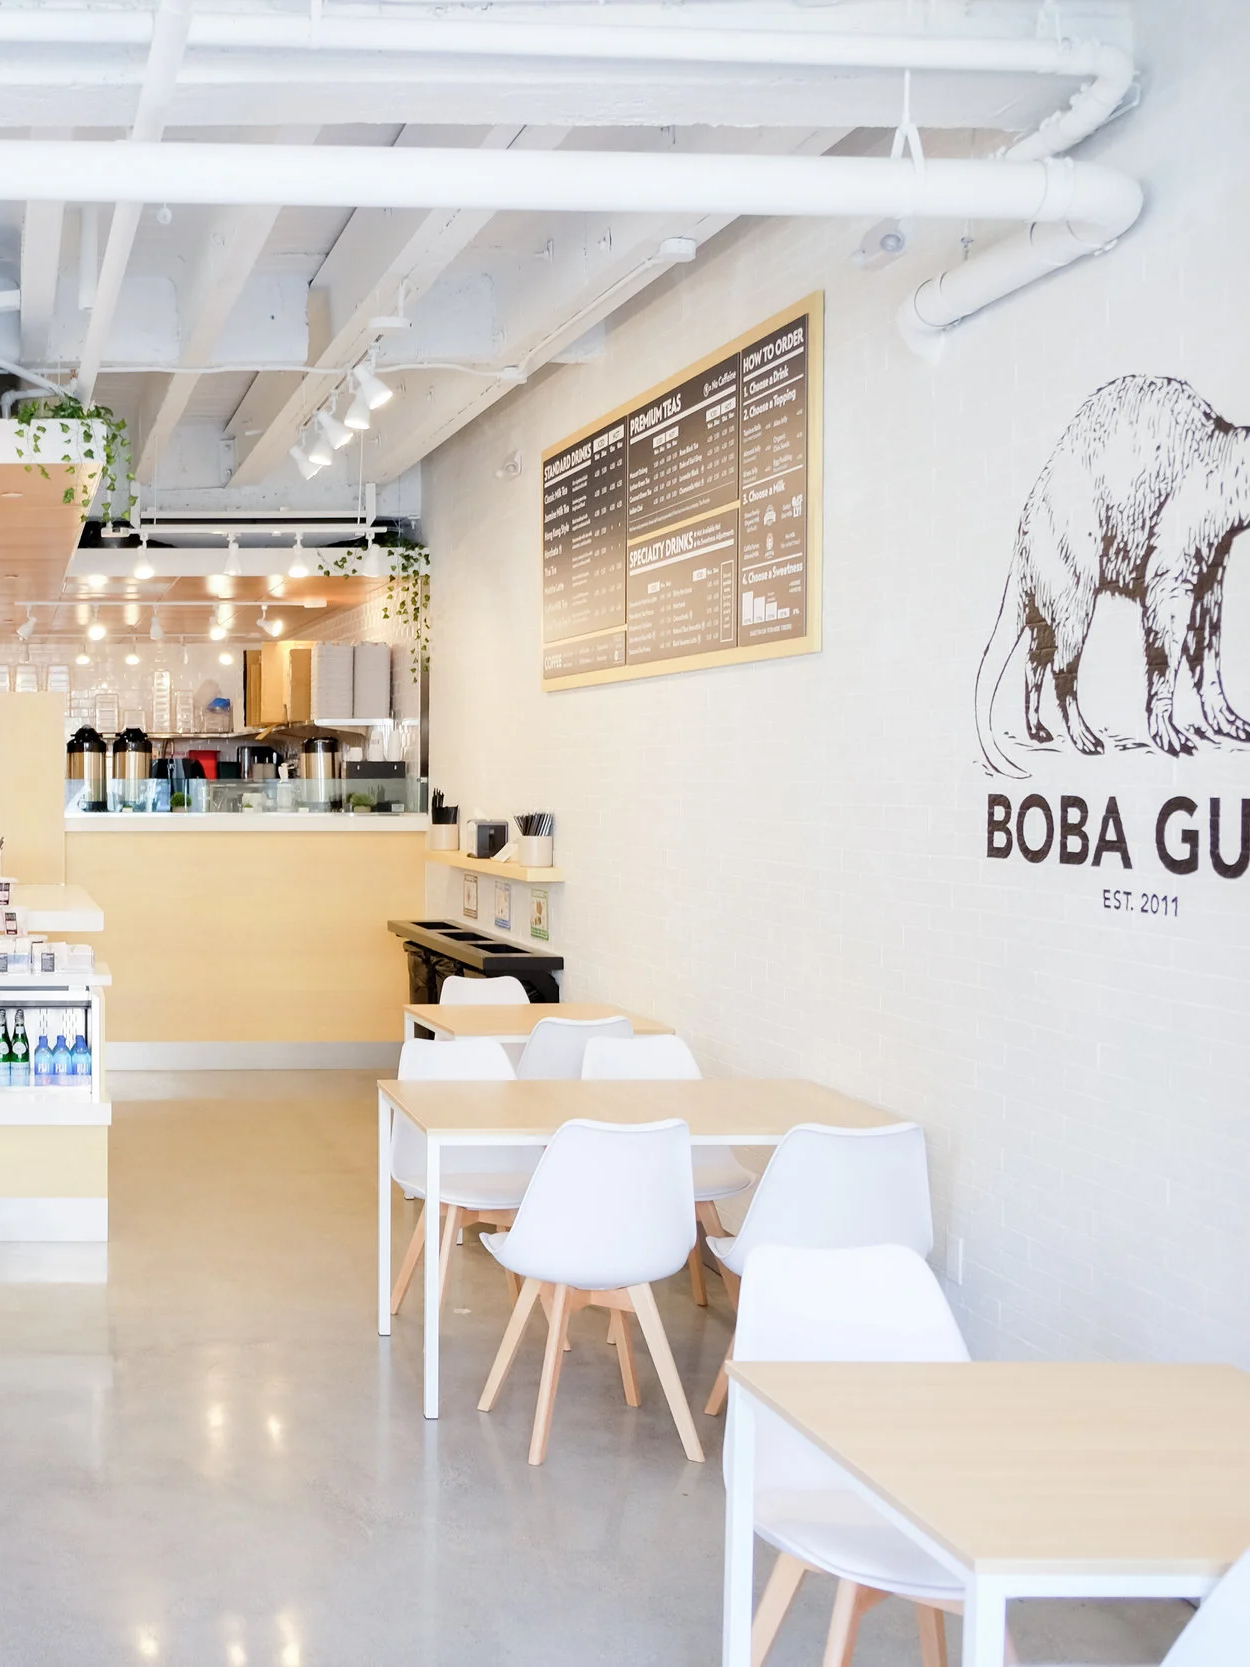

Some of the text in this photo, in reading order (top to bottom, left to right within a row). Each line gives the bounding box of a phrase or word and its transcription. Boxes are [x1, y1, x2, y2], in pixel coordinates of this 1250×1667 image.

[743, 327, 804, 373] HOW TO ORDER
[749, 378, 768, 394] Choose
[773, 365, 788, 383] Drink
[630, 393, 682, 436] PREMIUM TEAS
[744, 409, 749, 421] 2.
[749, 402, 768, 418] Choose
[773, 389, 796, 408] Topping
[544, 442, 592, 482] STANDARD DRINKS
[748, 488, 768, 502] Choose
[773, 479, 785, 494] Milk
[630, 541, 664, 568] SPECIALTY
[748, 571, 767, 584] Choose
[773, 562, 803, 578] Sweetness
[544, 654, 562, 670] COFFEE
[986, 793, 1250, 879] BOBA GU
[1102, 889, 1178, 917] EST. 2011
